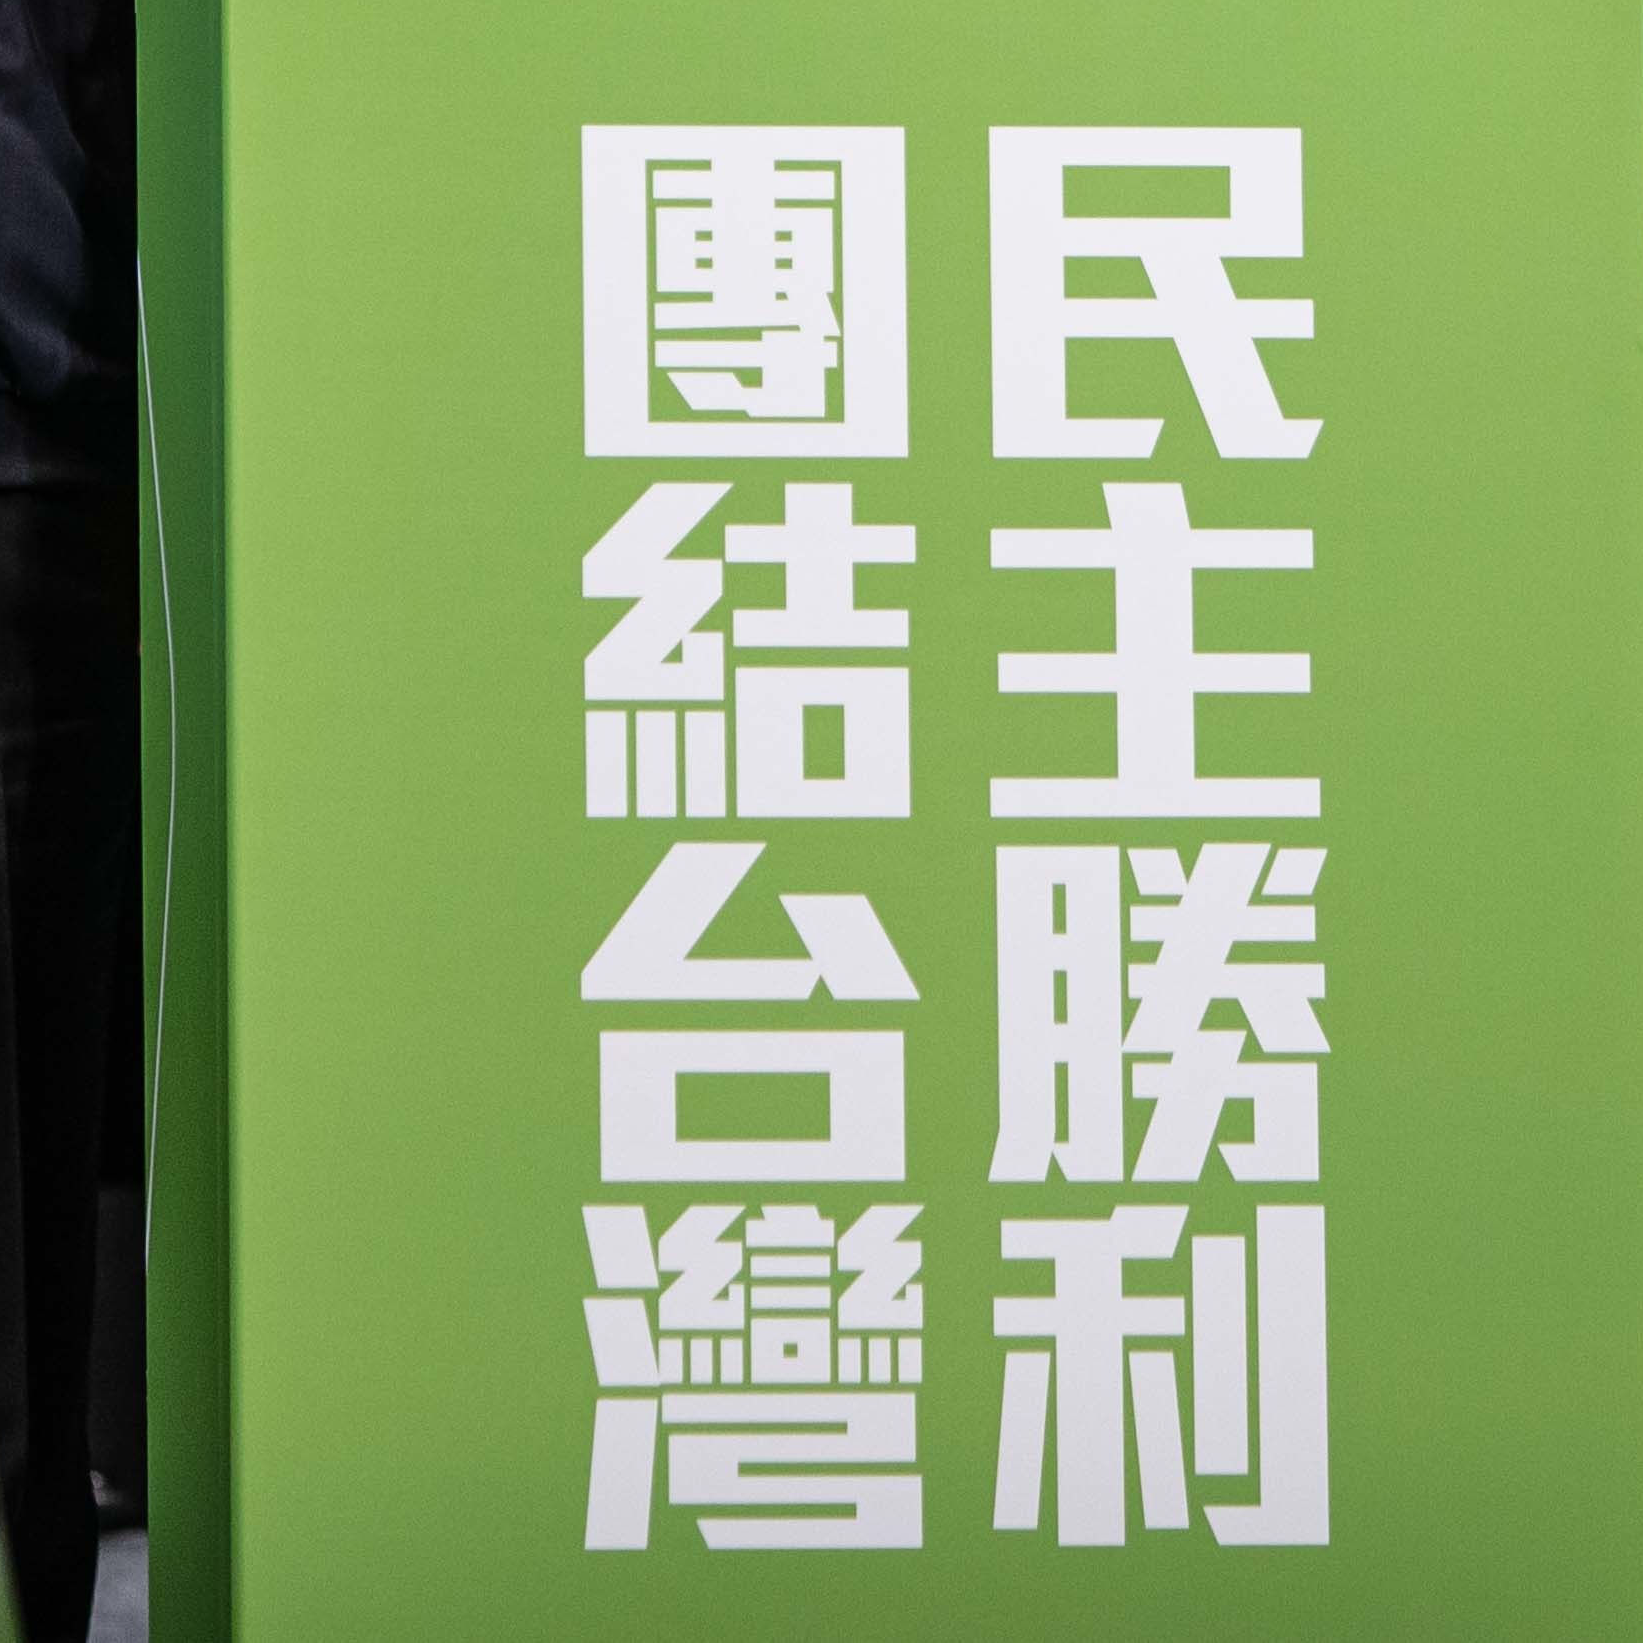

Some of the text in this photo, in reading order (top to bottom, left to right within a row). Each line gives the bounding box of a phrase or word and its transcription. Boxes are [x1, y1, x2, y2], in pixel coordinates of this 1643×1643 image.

[580, 124, 925, 1550] 團結台灣
[988, 126, 1331, 1546] 民主勝利
